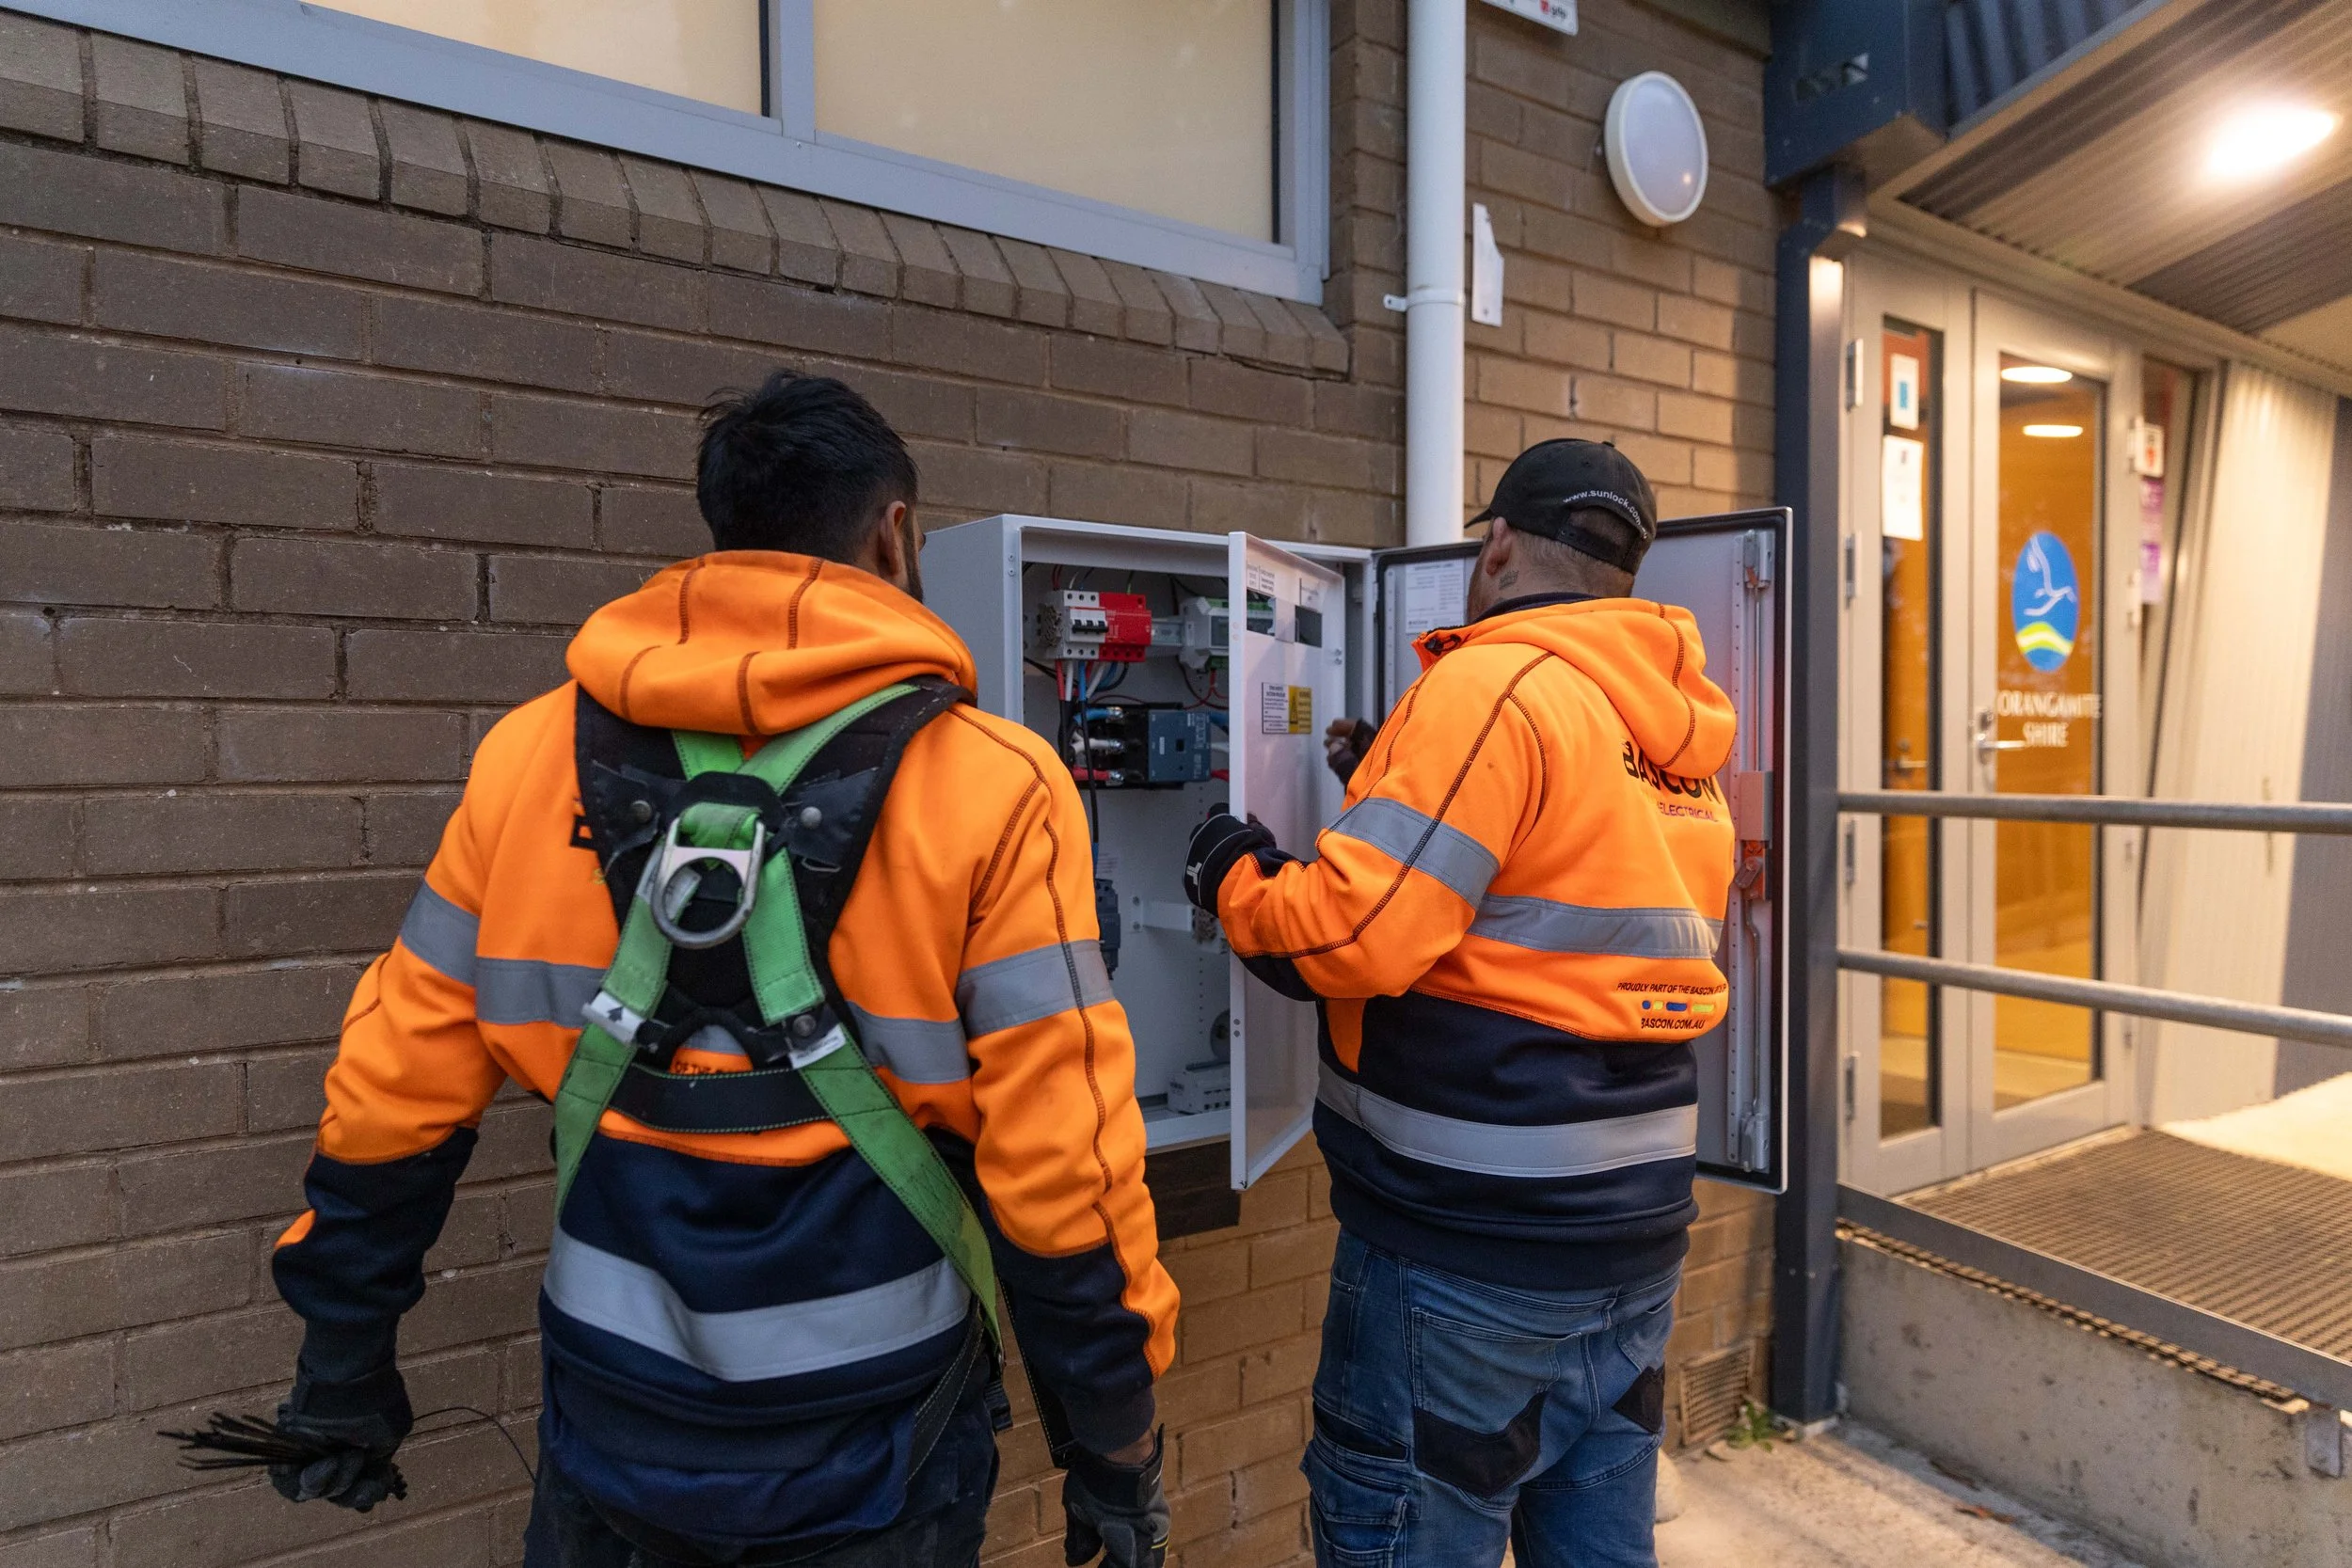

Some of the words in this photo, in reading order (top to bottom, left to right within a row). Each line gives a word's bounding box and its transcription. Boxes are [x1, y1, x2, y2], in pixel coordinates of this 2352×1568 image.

[1622, 740, 1722, 805] BASCON
[1657, 801, 1719, 822] ELECTRICAL
[1617, 982, 1649, 992] PROUDLY
[1650, 983, 1668, 992] PART
[1667, 984, 1678, 993] OF
[1678, 984, 1692, 994] THE
[1691, 986, 1714, 995] BASCON
[1641, 1018, 1706, 1030] BASCON.COM.AU
